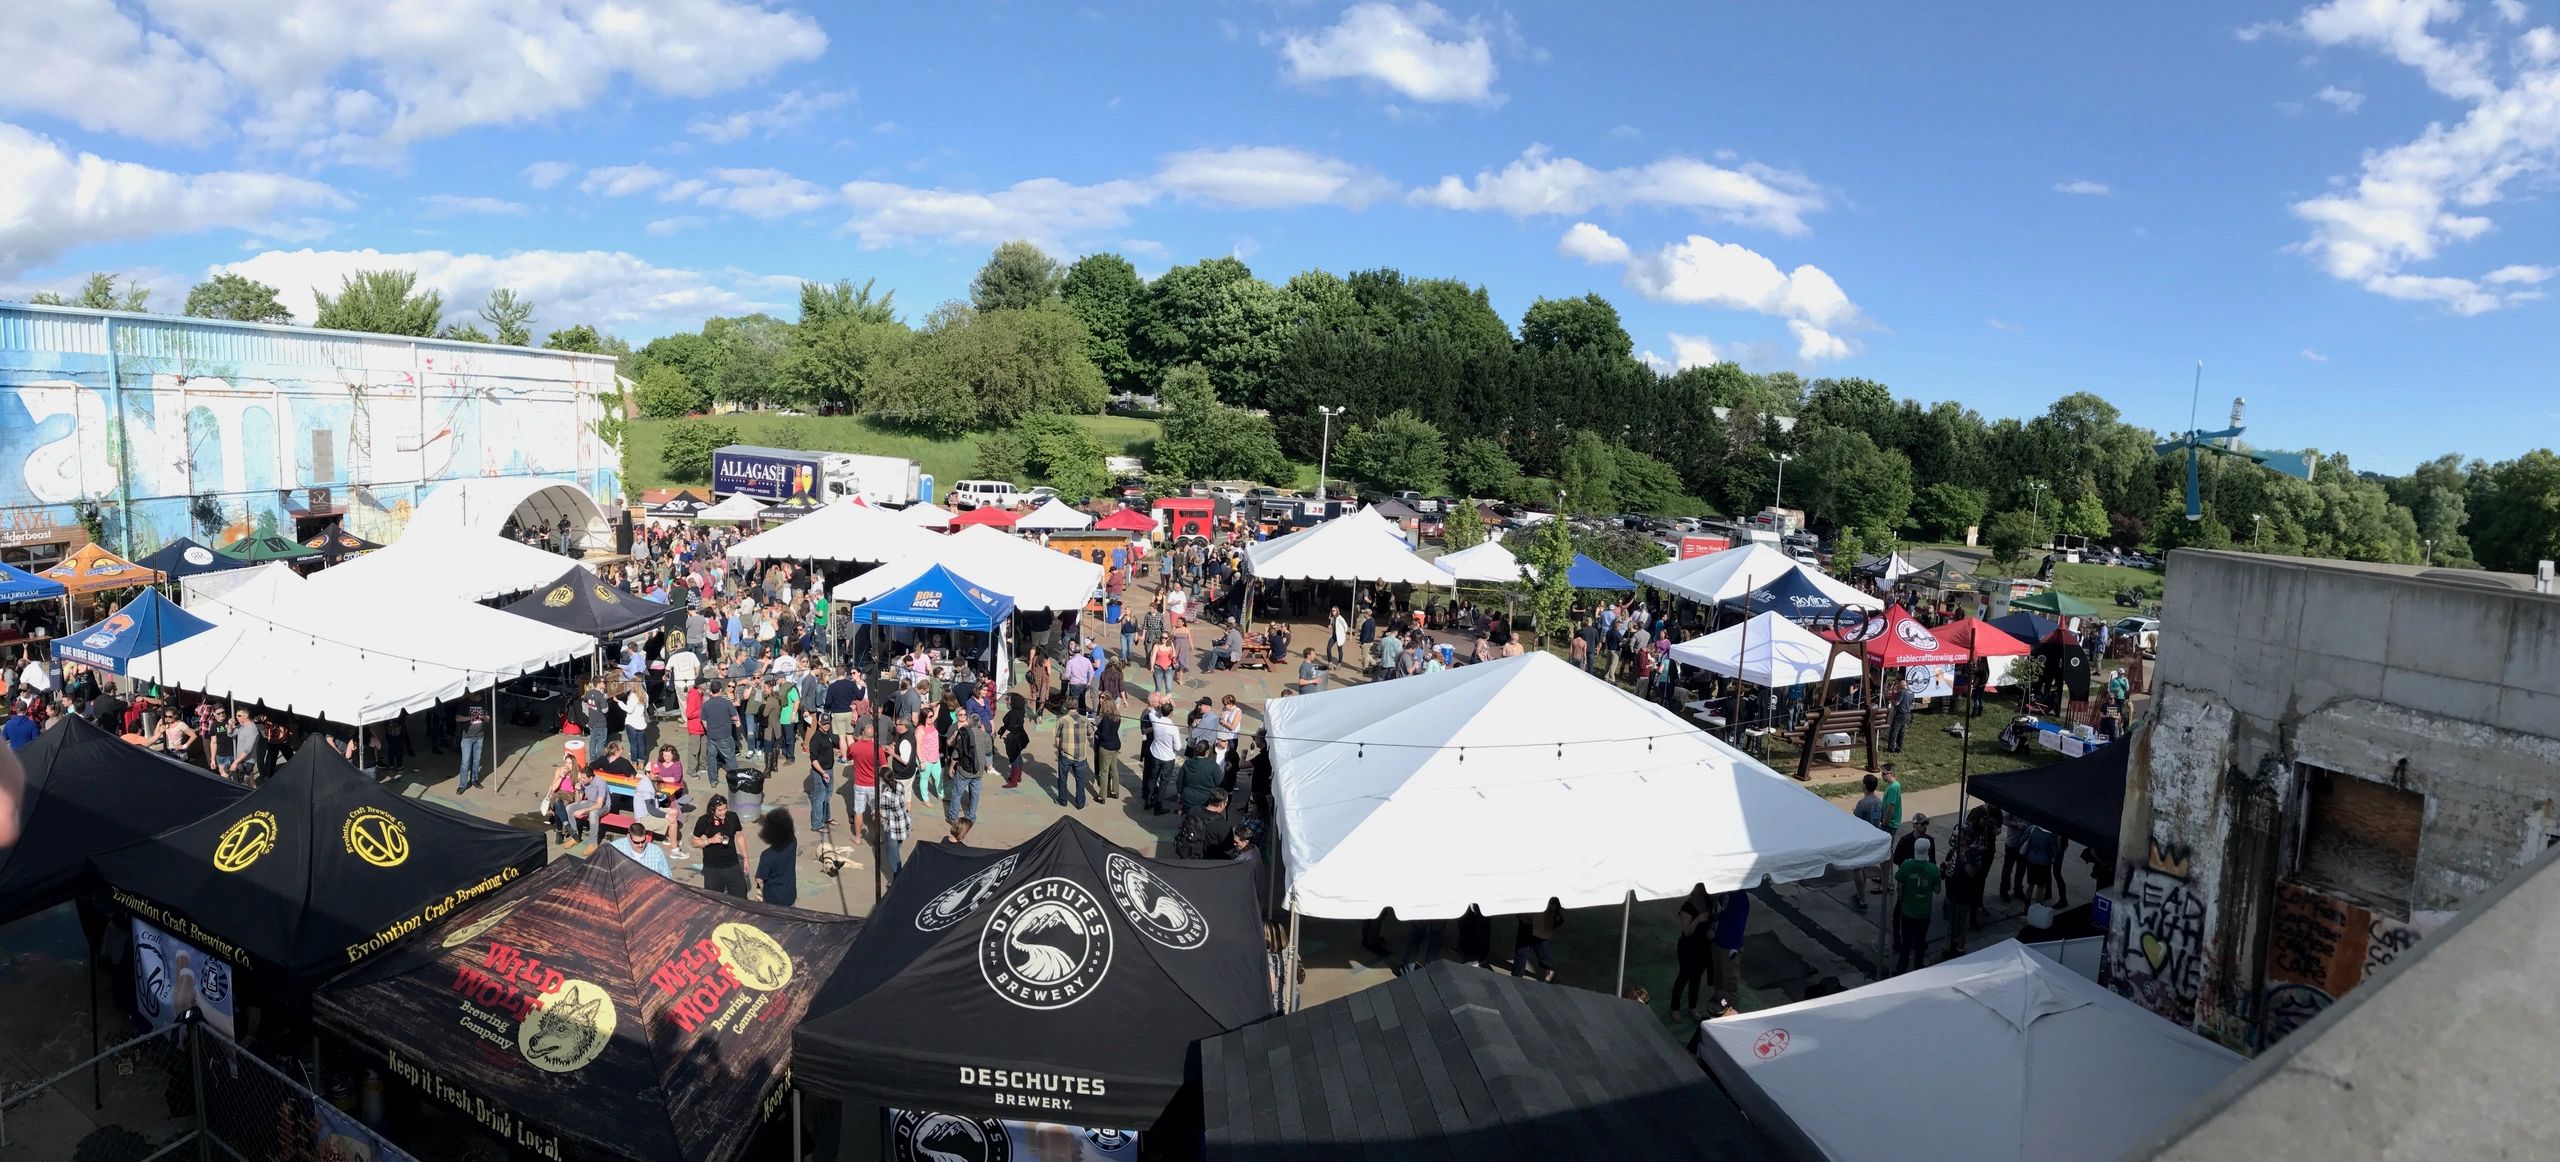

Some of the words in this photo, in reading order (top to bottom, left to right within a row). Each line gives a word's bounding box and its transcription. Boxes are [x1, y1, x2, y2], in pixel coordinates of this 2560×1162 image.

[720, 459, 786, 482] ALLAGASH
[912, 599, 940, 608] ROCK
[915, 591, 943, 601] BOLD
[1789, 594, 1831, 608] Skyline
[60, 644, 72, 656] BLUE
[72, 647, 87, 660] RIDGE
[87, 651, 114, 668] GRAPHICS
[1896, 653, 1968, 663] stablecraftbrewing.com
[219, 813, 253, 840] Evolution
[254, 810, 270, 819] Craft
[342, 818, 352, 854] Evolution
[349, 806, 366, 818] Craft
[366, 805, 396, 822] Brewing
[992, 883, 1105, 936] DESCHUTES
[2122, 866, 2205, 920] LEAD
[112, 886, 161, 922] Evolution
[162, 910, 188, 934] Craft
[190, 922, 233, 960] Brewing
[346, 914, 422, 963] Evolution
[424, 896, 455, 922] Craft
[455, 874, 502, 905] Brewing
[502, 866, 520, 882] Co.
[483, 941, 565, 995] WILD
[650, 938, 722, 997] WILD
[996, 971, 1084, 1001] BREWERY
[451, 964, 545, 1024] WOLF
[669, 962, 742, 1034] WOLF
[711, 992, 752, 1032] Brewing
[459, 1000, 510, 1034] Brewing
[459, 1016, 514, 1050] Company
[732, 994, 769, 1035] Company
[960, 1066, 1106, 1096] DESCHUTES
[389, 1049, 419, 1086] Keep
[422, 1069, 432, 1094] it
[435, 1076, 474, 1116] Fresh.
[476, 1097, 512, 1138] Drink
[517, 1120, 562, 1162] Local.
[764, 1082, 784, 1123] Keep
